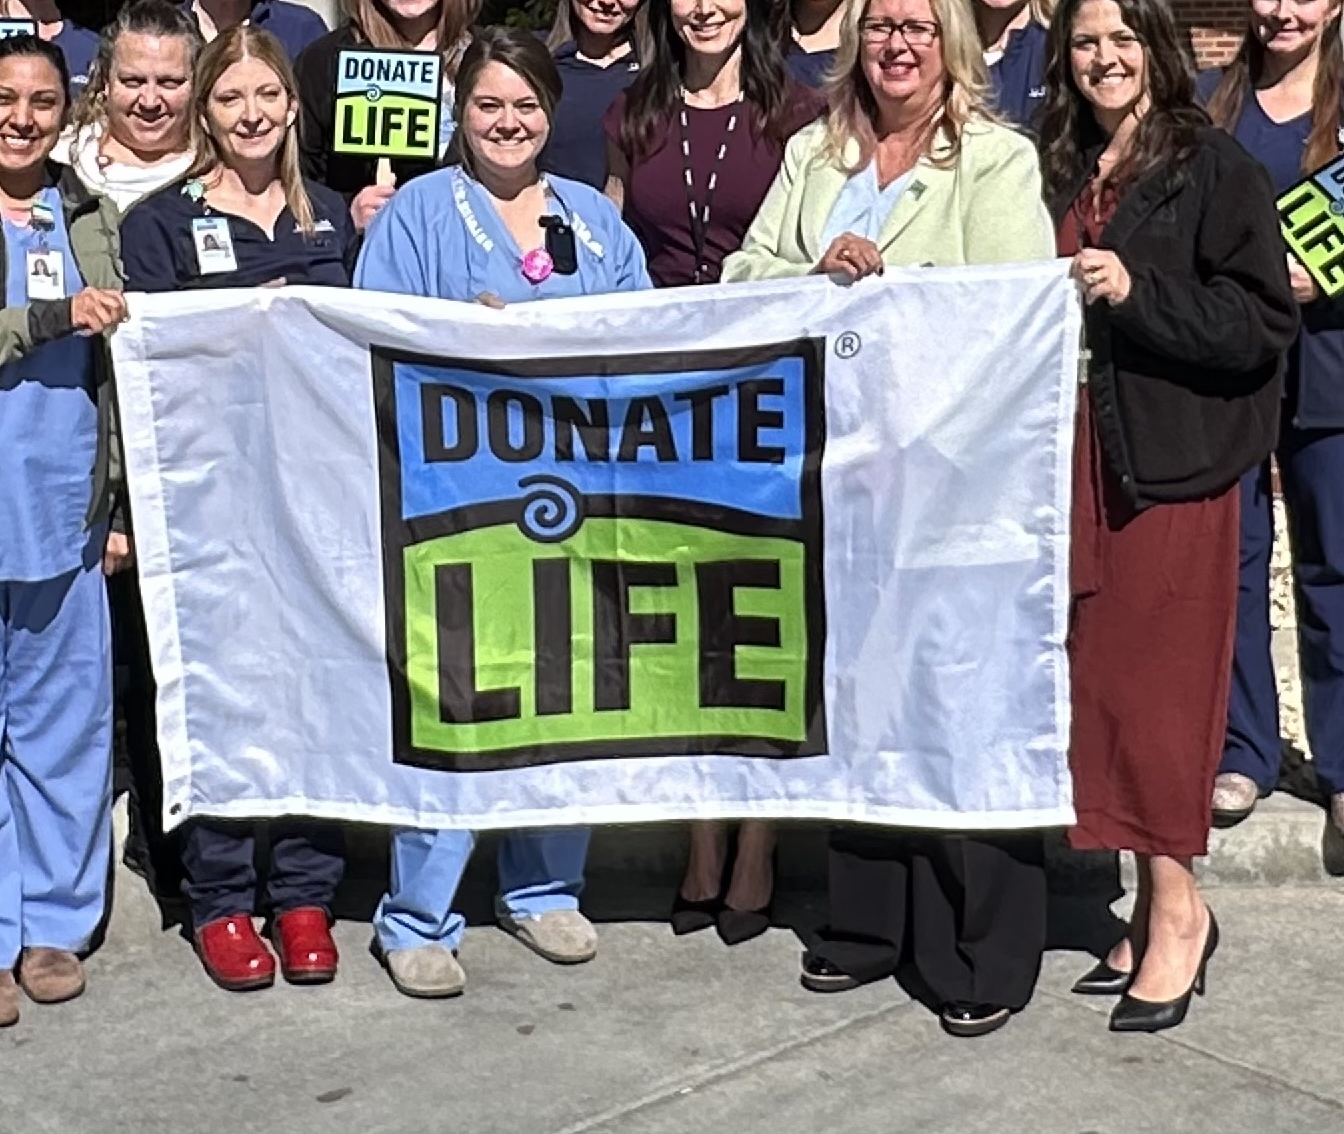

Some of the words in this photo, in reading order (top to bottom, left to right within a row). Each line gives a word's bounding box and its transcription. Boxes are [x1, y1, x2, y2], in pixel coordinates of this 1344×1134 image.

[344, 57, 434, 84] DONATE
[342, 104, 430, 148] LIFE
[419, 377, 787, 464] DONATE
[433, 556, 787, 724] LIFE
